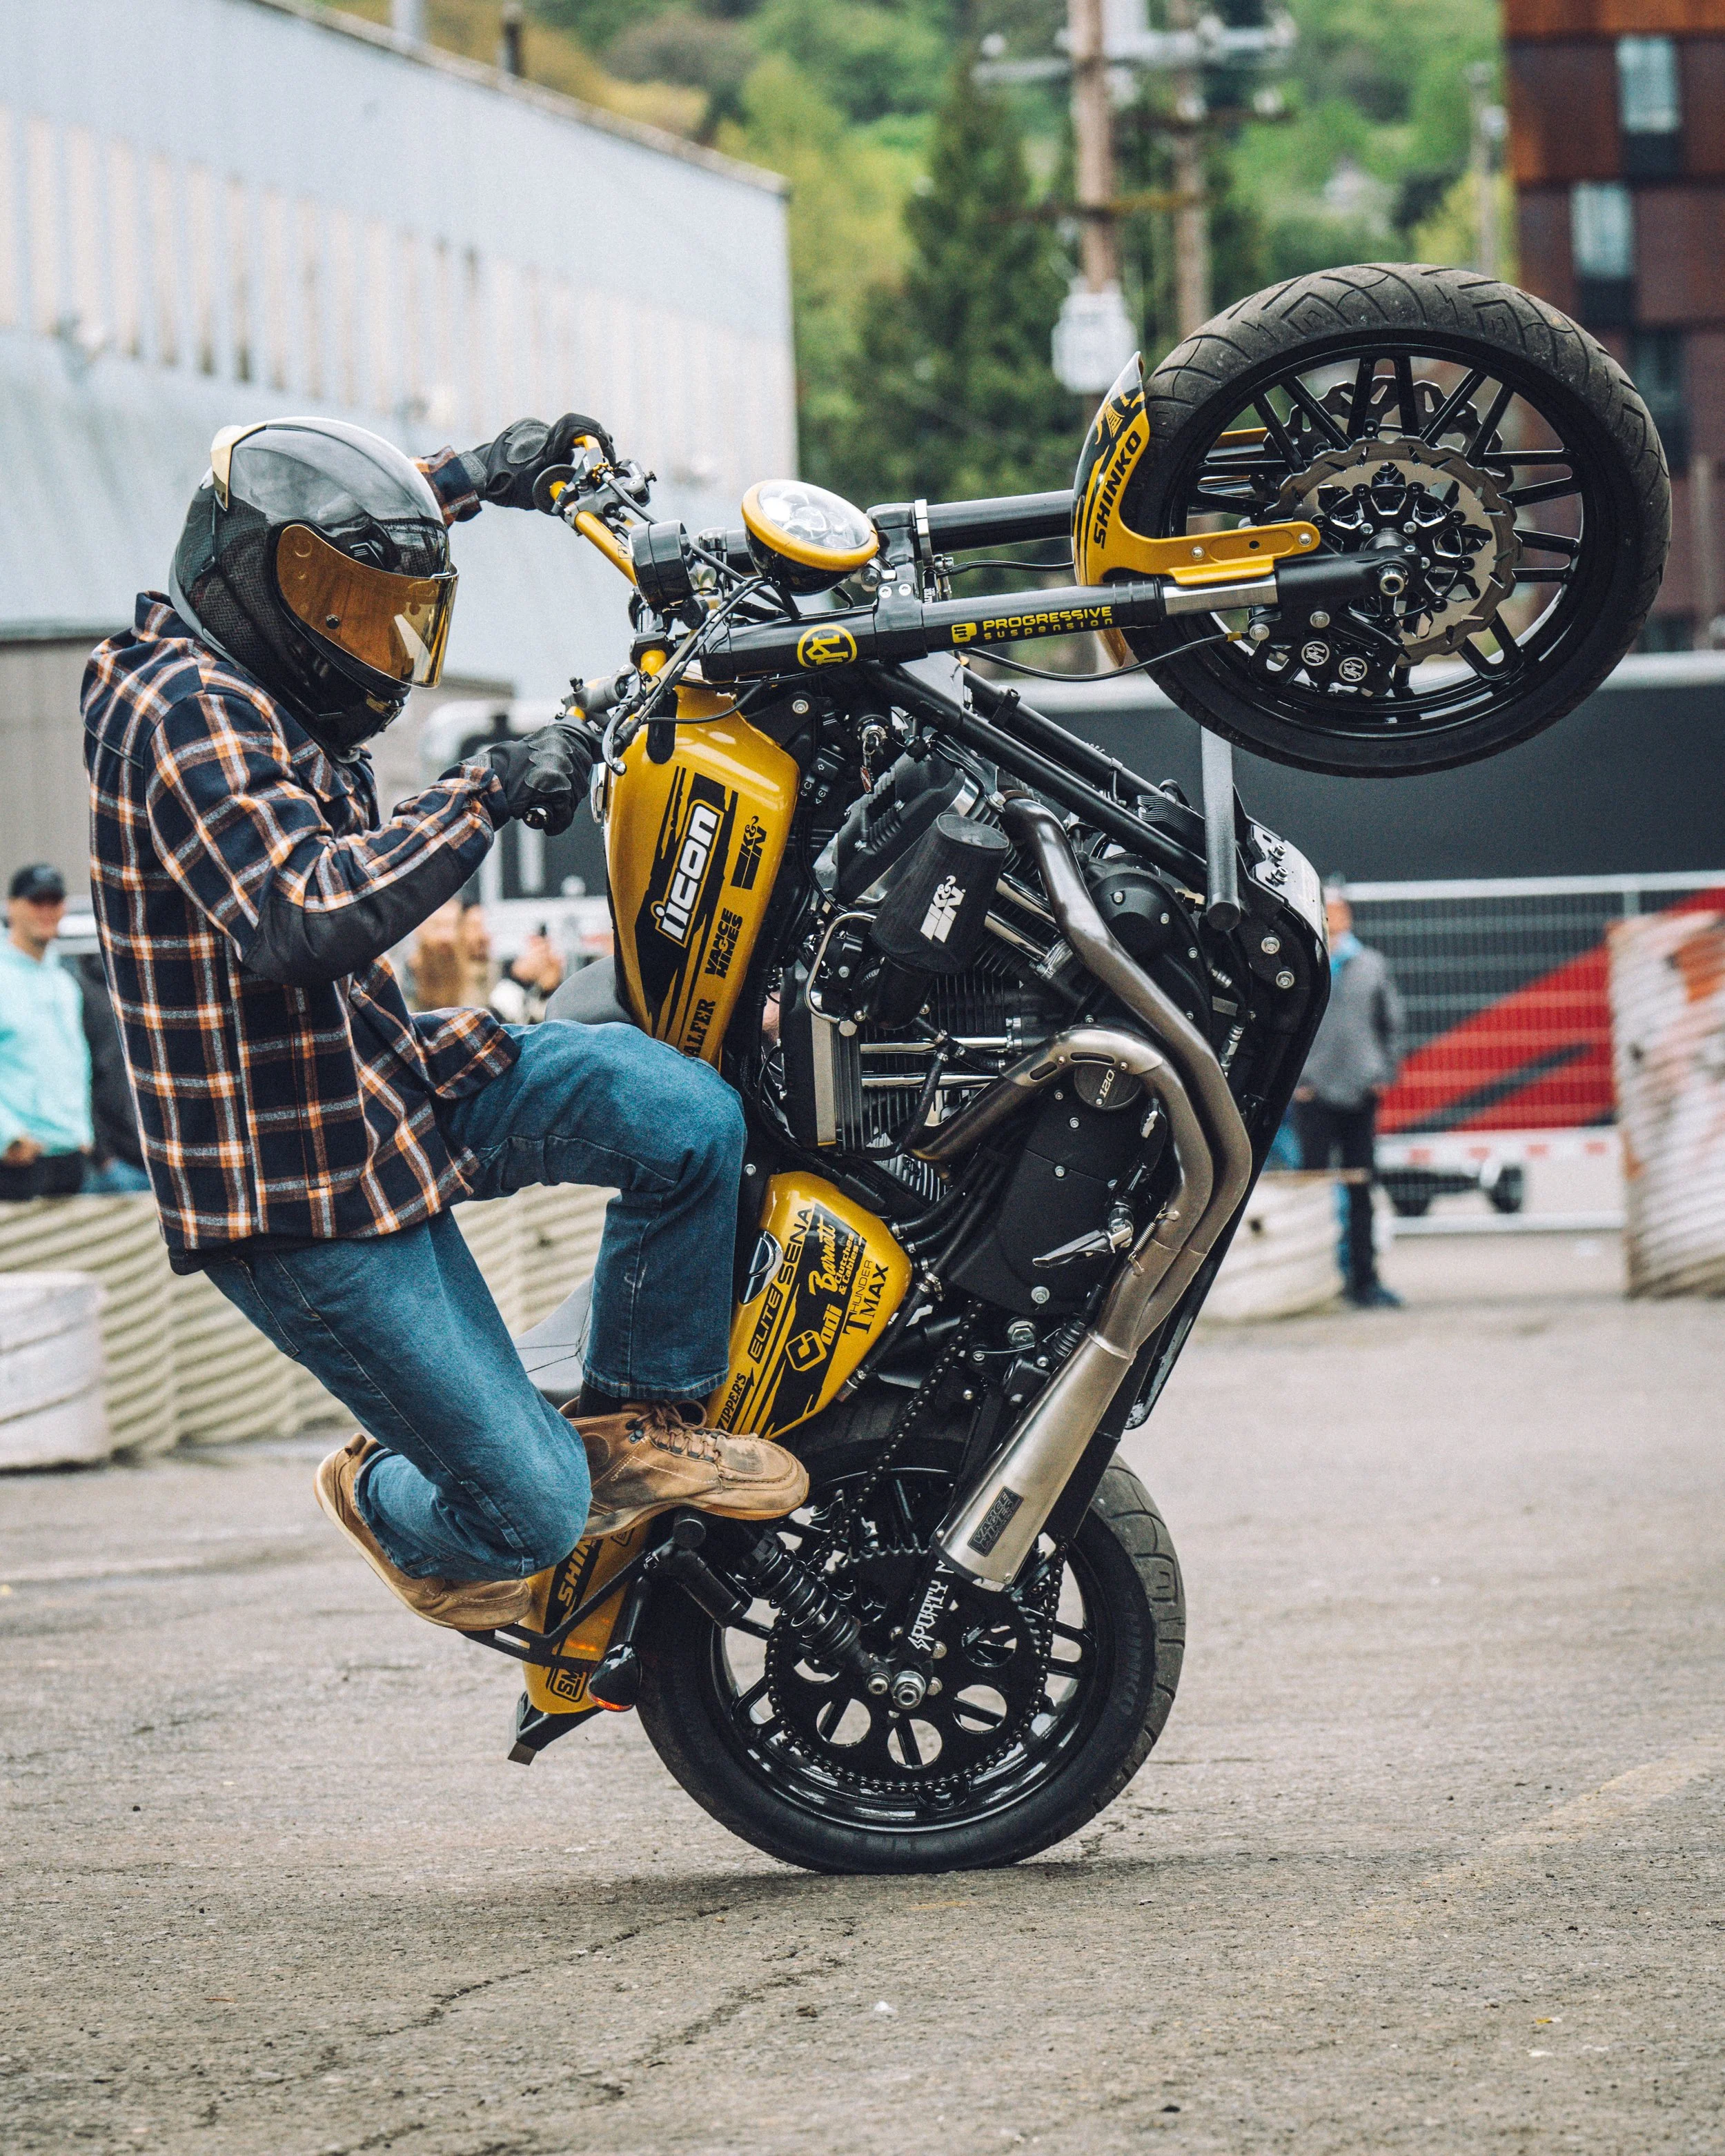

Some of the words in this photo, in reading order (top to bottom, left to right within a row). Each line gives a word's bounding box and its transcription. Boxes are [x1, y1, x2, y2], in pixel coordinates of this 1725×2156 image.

[1094, 431, 1142, 550] SHINKO
[983, 606, 1112, 631] PROGRESSIVE
[983, 617, 1113, 640] suspension
[656, 805, 718, 940] icon
[730, 815, 767, 891] K&N
[704, 907, 733, 975] VANCE
[920, 875, 966, 943] K&N
[716, 914, 744, 979] HINES
[683, 998, 716, 1058] ALFER
[1100, 1069, 1116, 1098] 120
[778, 1208, 812, 1285] SENA
[808, 1214, 838, 1296] Barnett
[834, 1232, 854, 1285] Clutches
[842, 1245, 859, 1284] Cables
[750, 1287, 780, 1358] ELITE
[838, 1285, 847, 1295] &
[715, 1372, 747, 1431] ZIPPER'S
[558, 1539, 593, 1607] SHIN
[907, 1579, 949, 1651] SPORTY
[557, 1668, 579, 1695] SM
